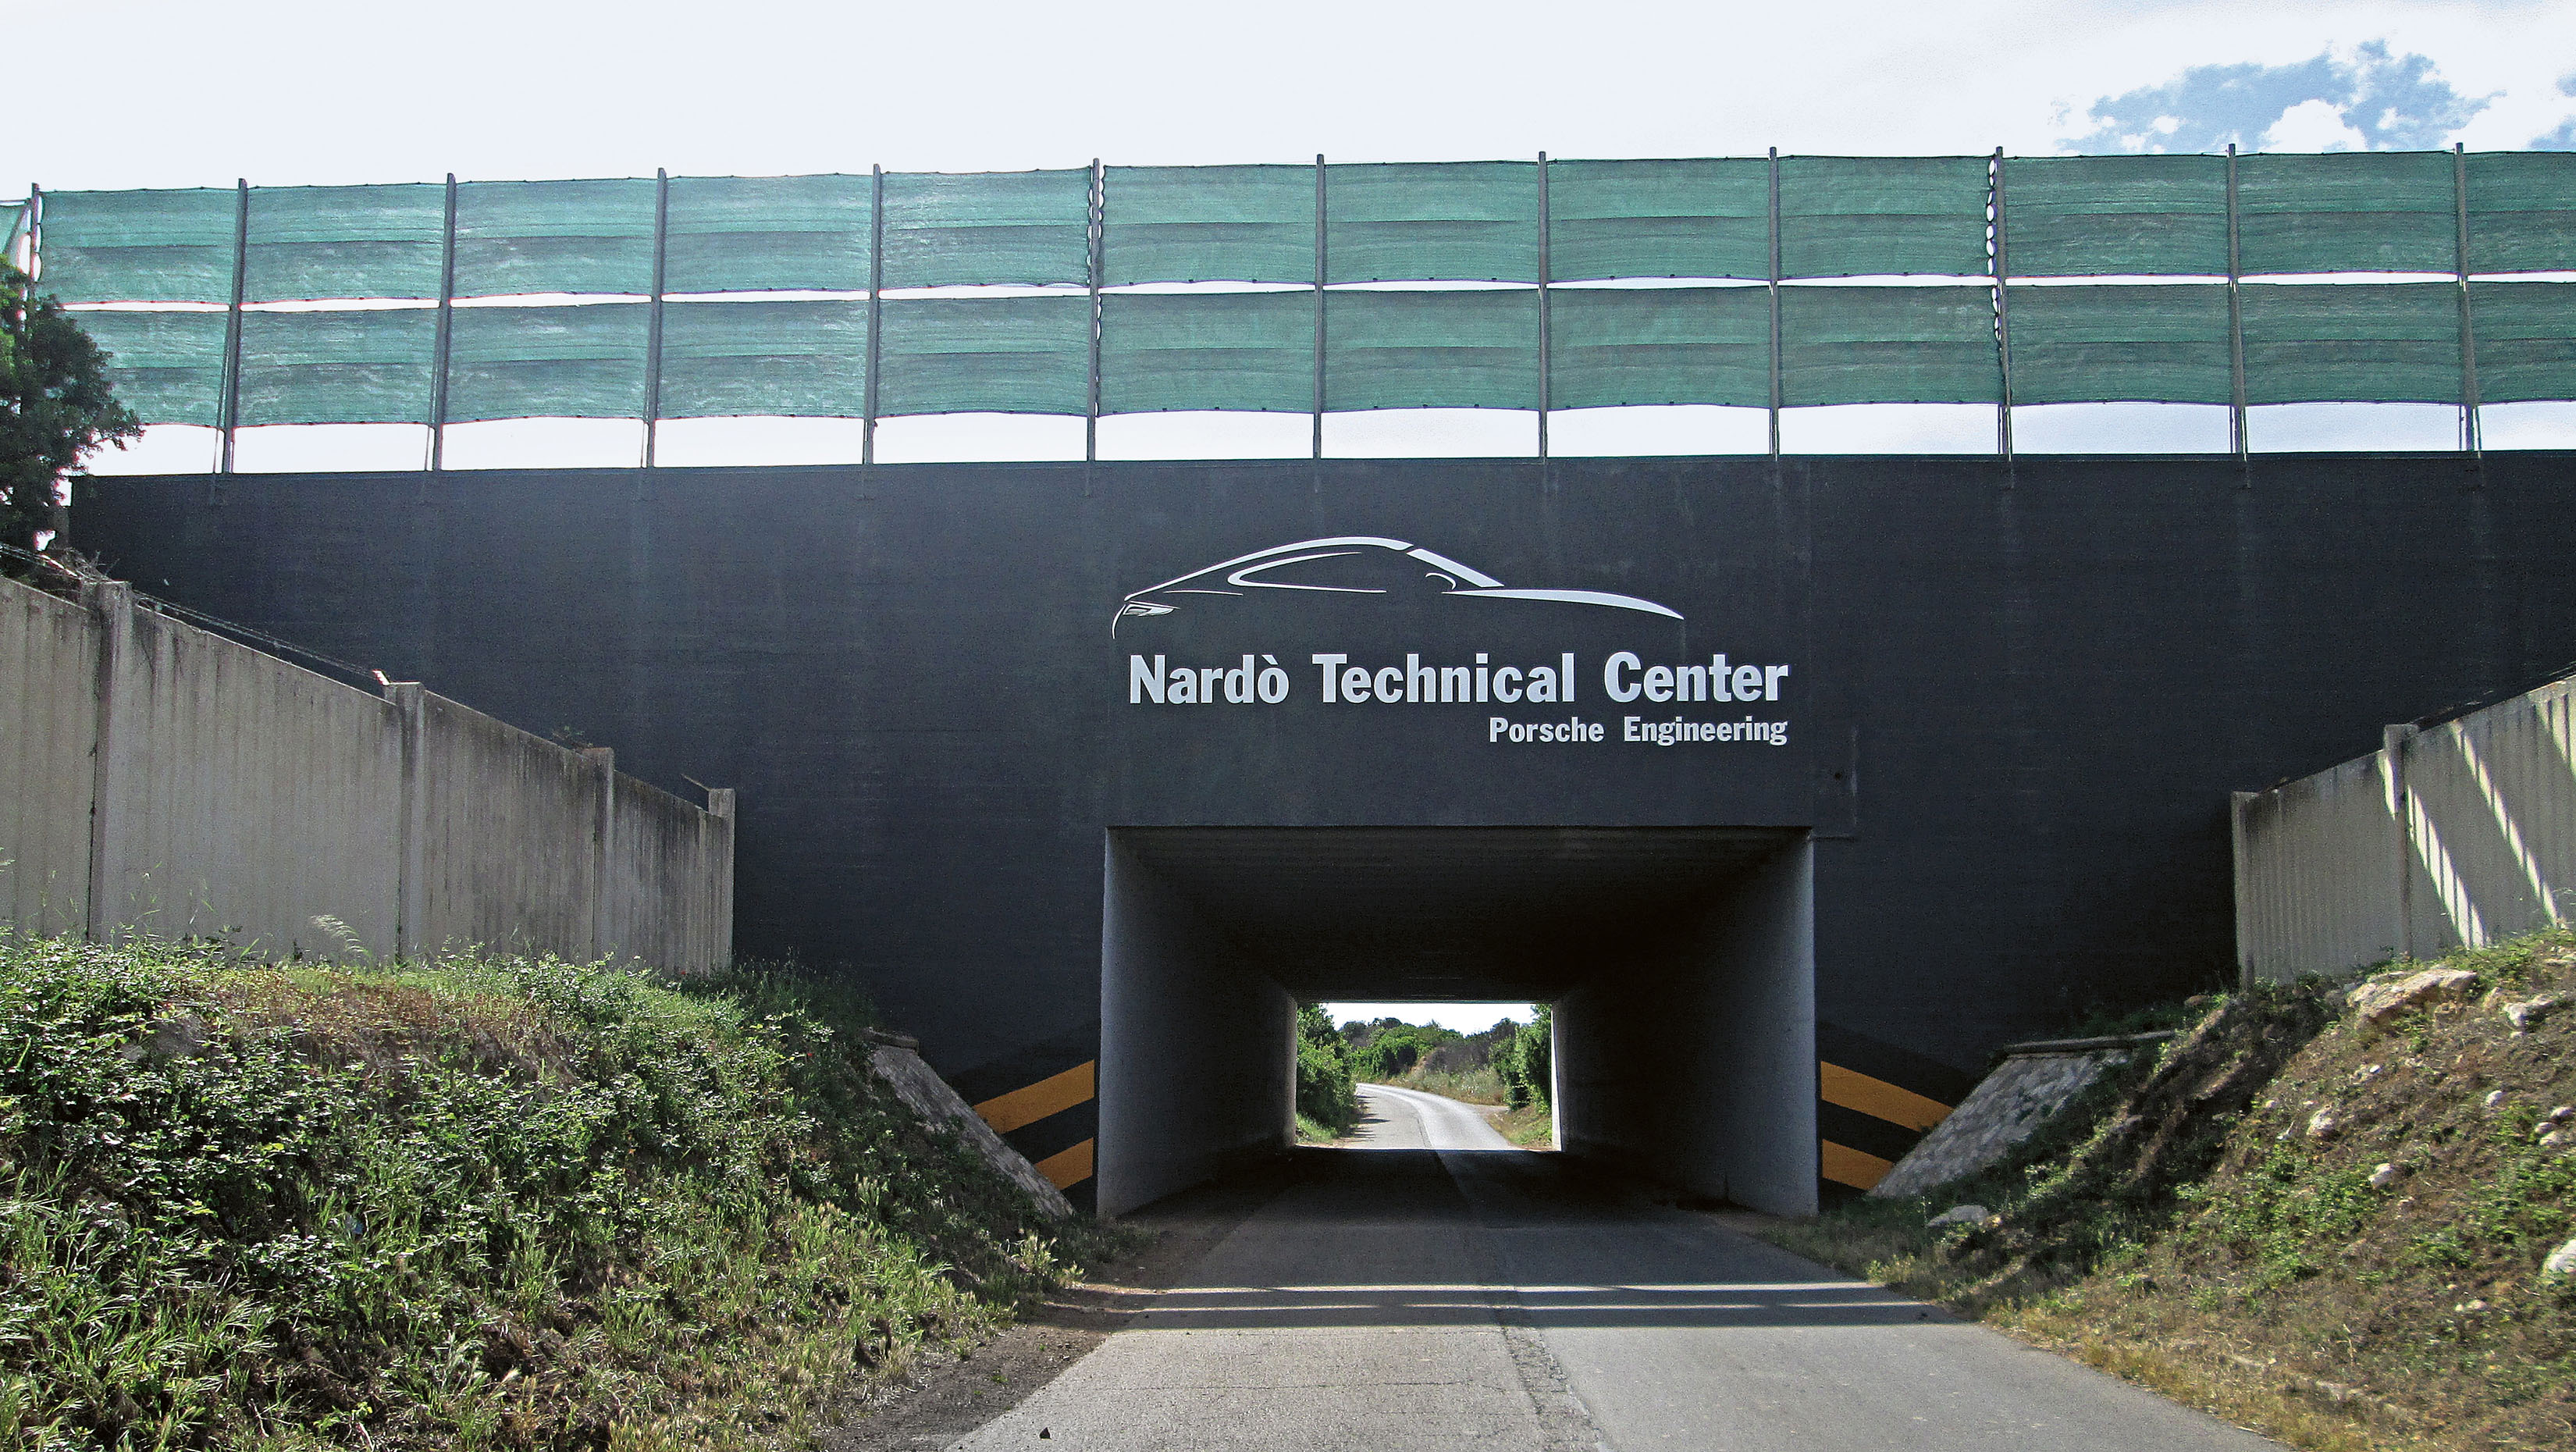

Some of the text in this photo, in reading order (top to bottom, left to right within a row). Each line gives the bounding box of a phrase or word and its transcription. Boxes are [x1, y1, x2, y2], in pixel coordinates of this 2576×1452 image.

[1130, 651, 1789, 704] Nardò Technical Center
[1489, 715, 1788, 746] Porsche Engineering
